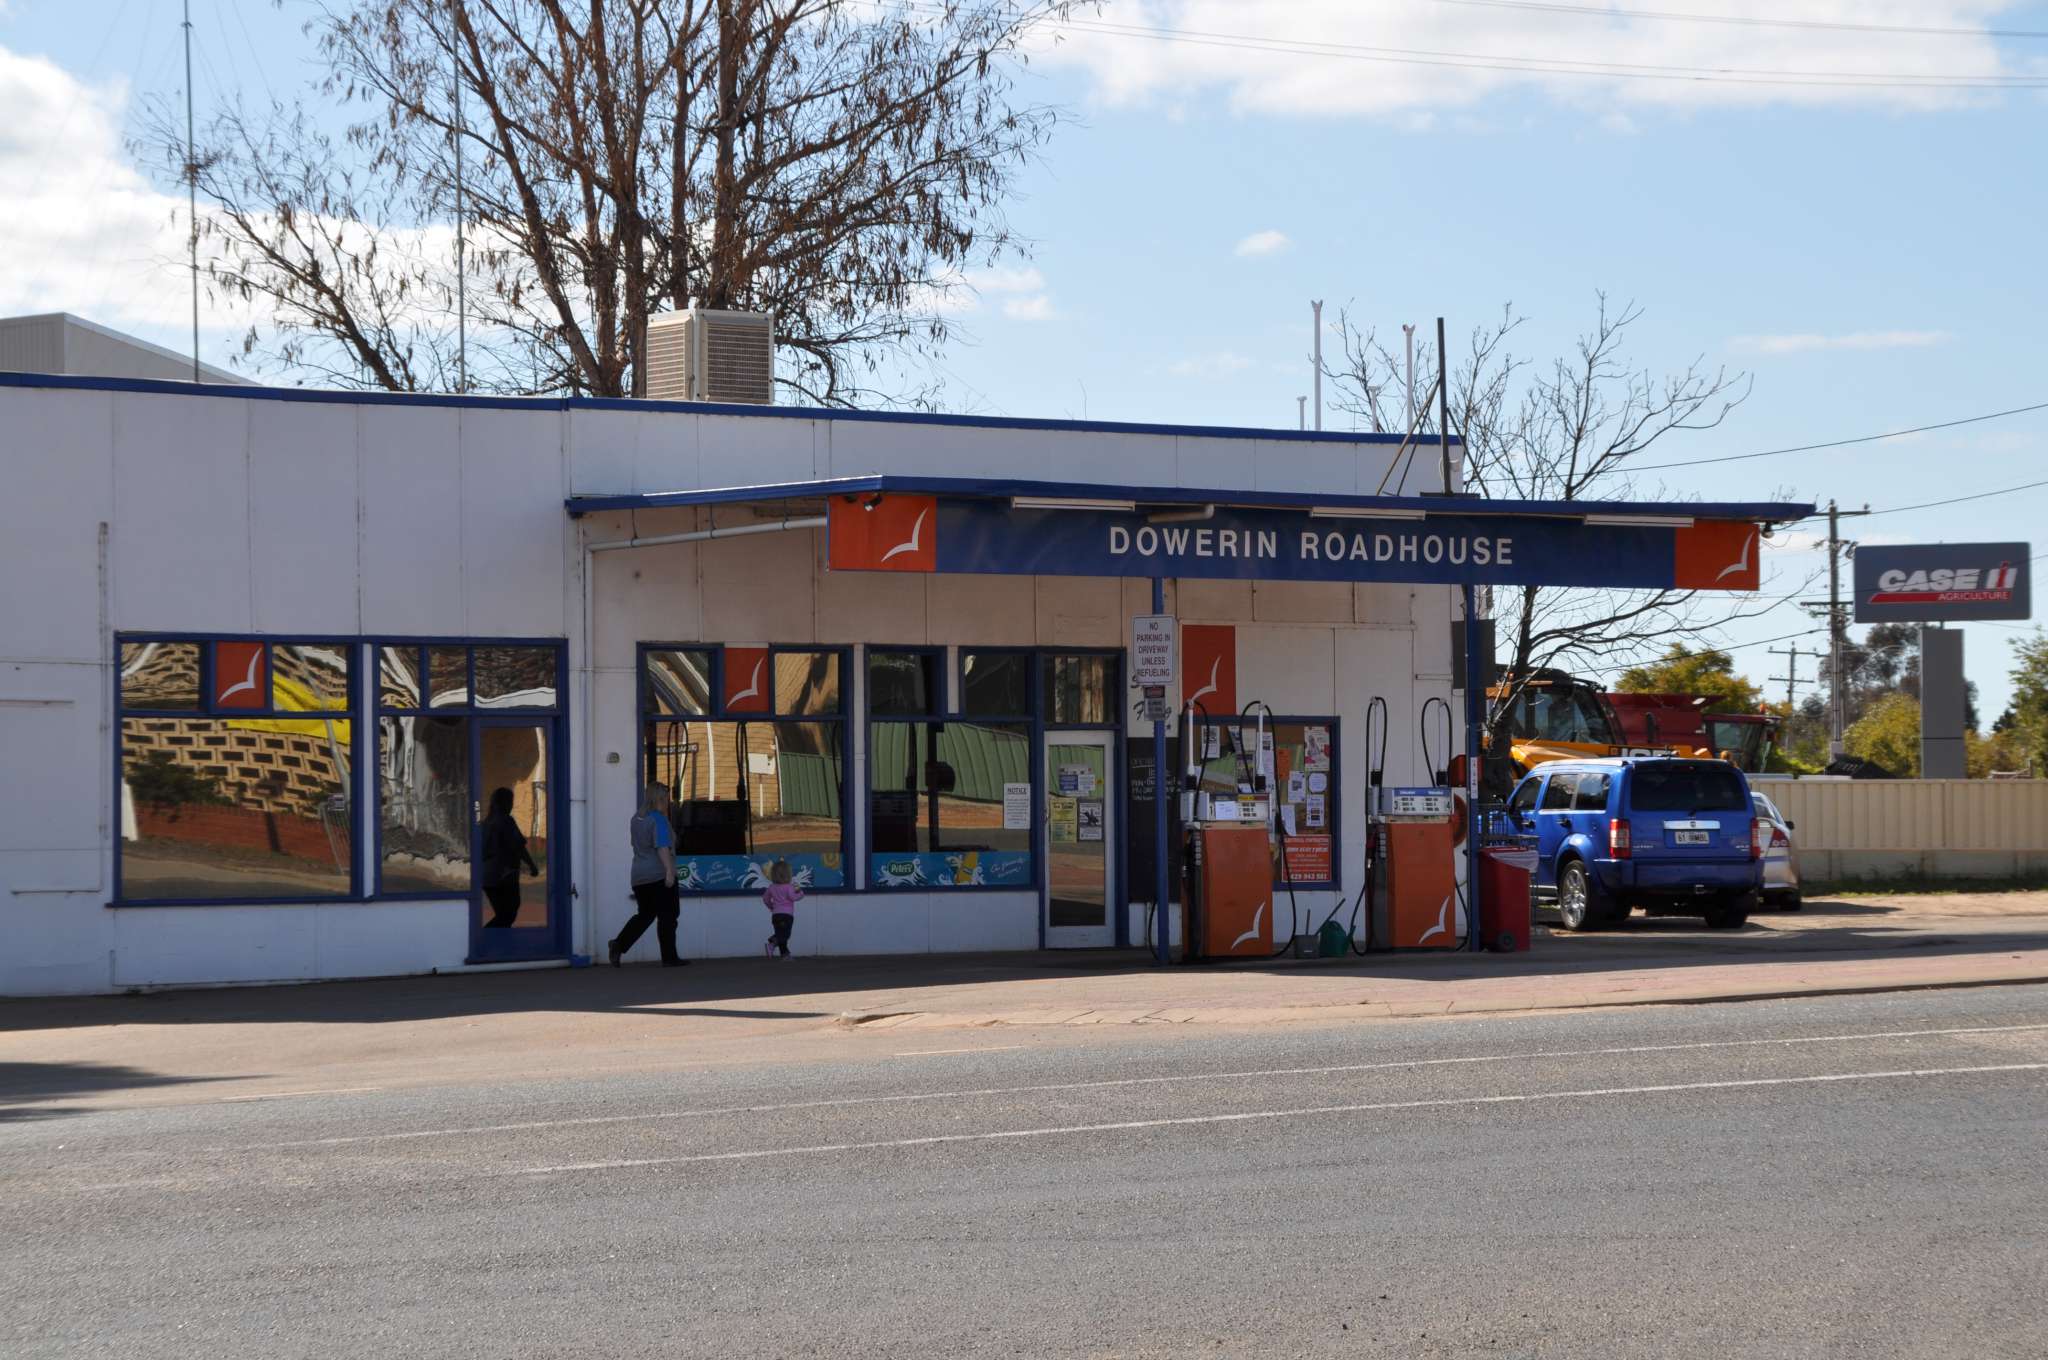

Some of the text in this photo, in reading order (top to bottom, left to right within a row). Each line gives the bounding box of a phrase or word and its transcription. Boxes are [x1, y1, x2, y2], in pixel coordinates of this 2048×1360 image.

[1110, 526, 1513, 565] DOWERIN ROADHOUSE
[1878, 568, 1981, 592] CASE
[1938, 591, 2009, 601] AGRICULTURE
[1149, 622, 1159, 631] NO
[1136, 633, 1171, 642] PARKING IN
[1138, 645, 1168, 654] DRIVEWAY
[1141, 656, 1166, 665] UNLESS
[1136, 668, 1170, 677] REFUELING
